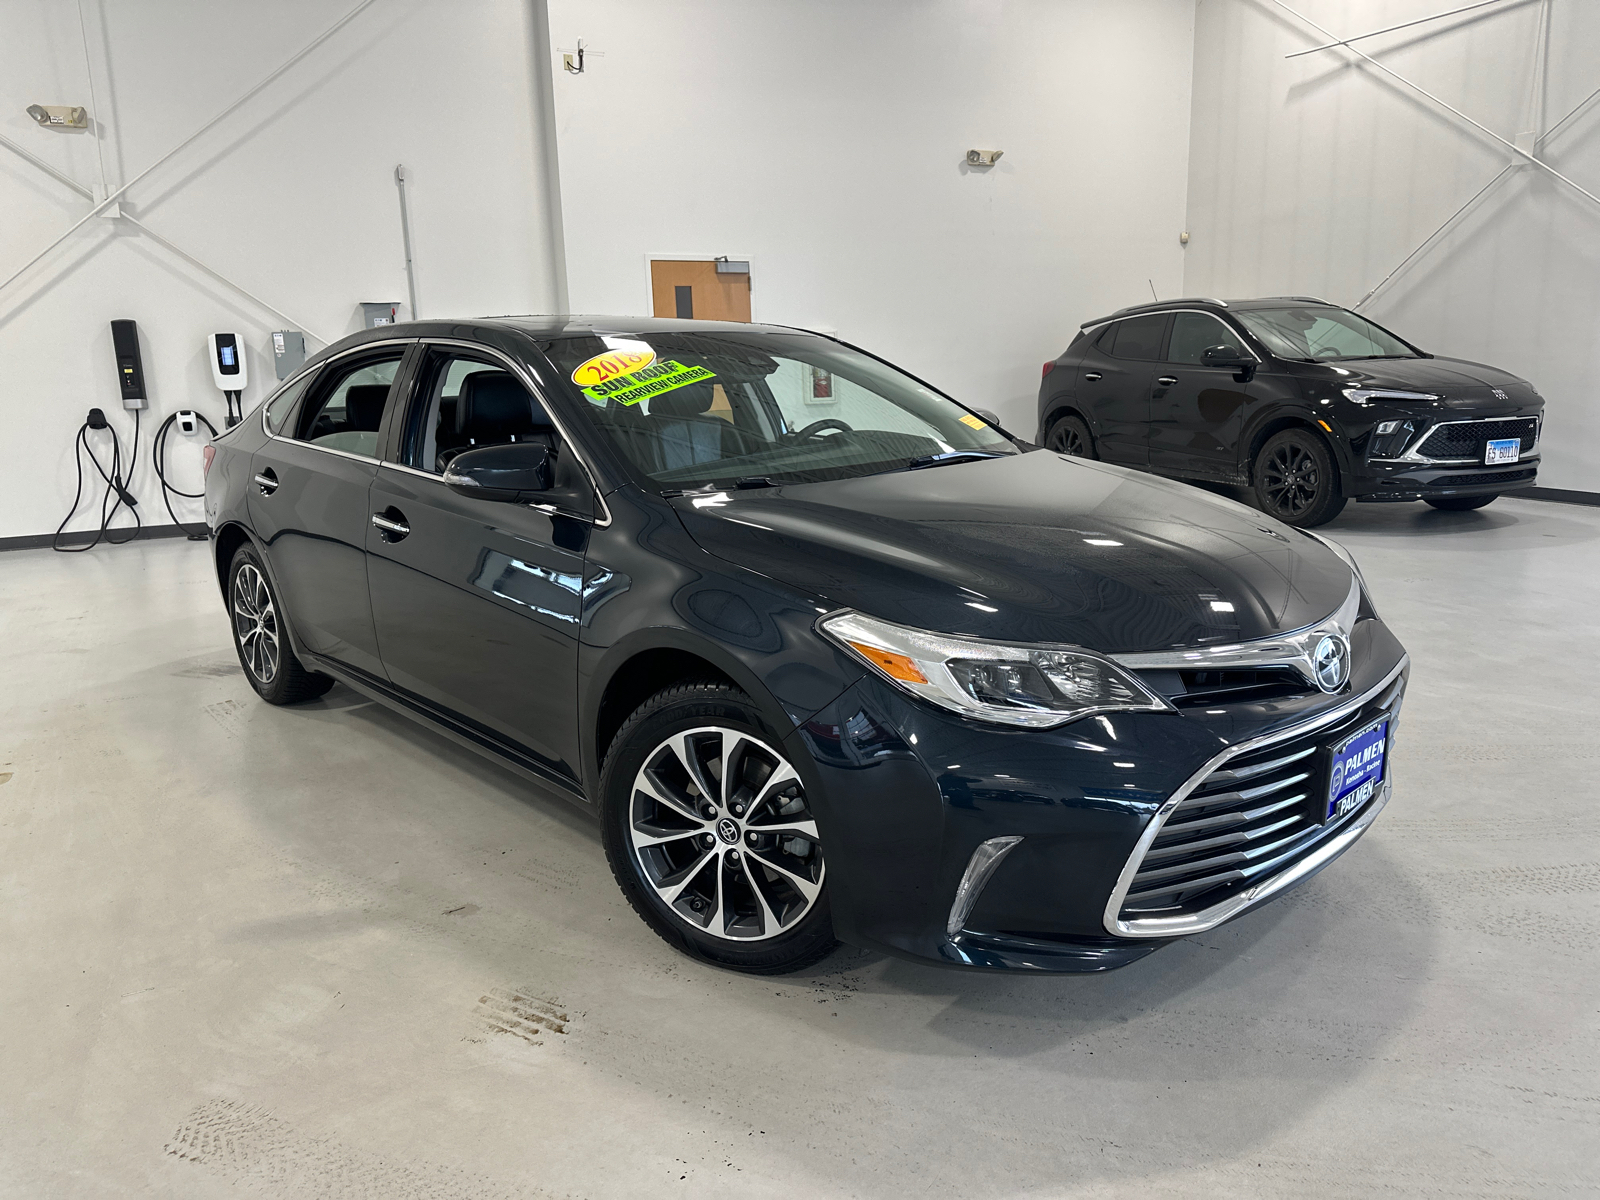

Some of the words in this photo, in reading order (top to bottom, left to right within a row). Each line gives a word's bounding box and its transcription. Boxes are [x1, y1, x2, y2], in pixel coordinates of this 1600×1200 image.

[587, 351, 642, 382] 2018
[590, 376, 635, 397] SUN
[633, 361, 679, 383] ROOF
[614, 379, 670, 404] REARVIEW
[667, 367, 711, 386] CAMERA
[1344, 737, 1386, 776] PALMEN
[1345, 770, 1364, 786] Kenosha
[1366, 760, 1381, 773] Racine
[1340, 780, 1374, 816] PALMEN
